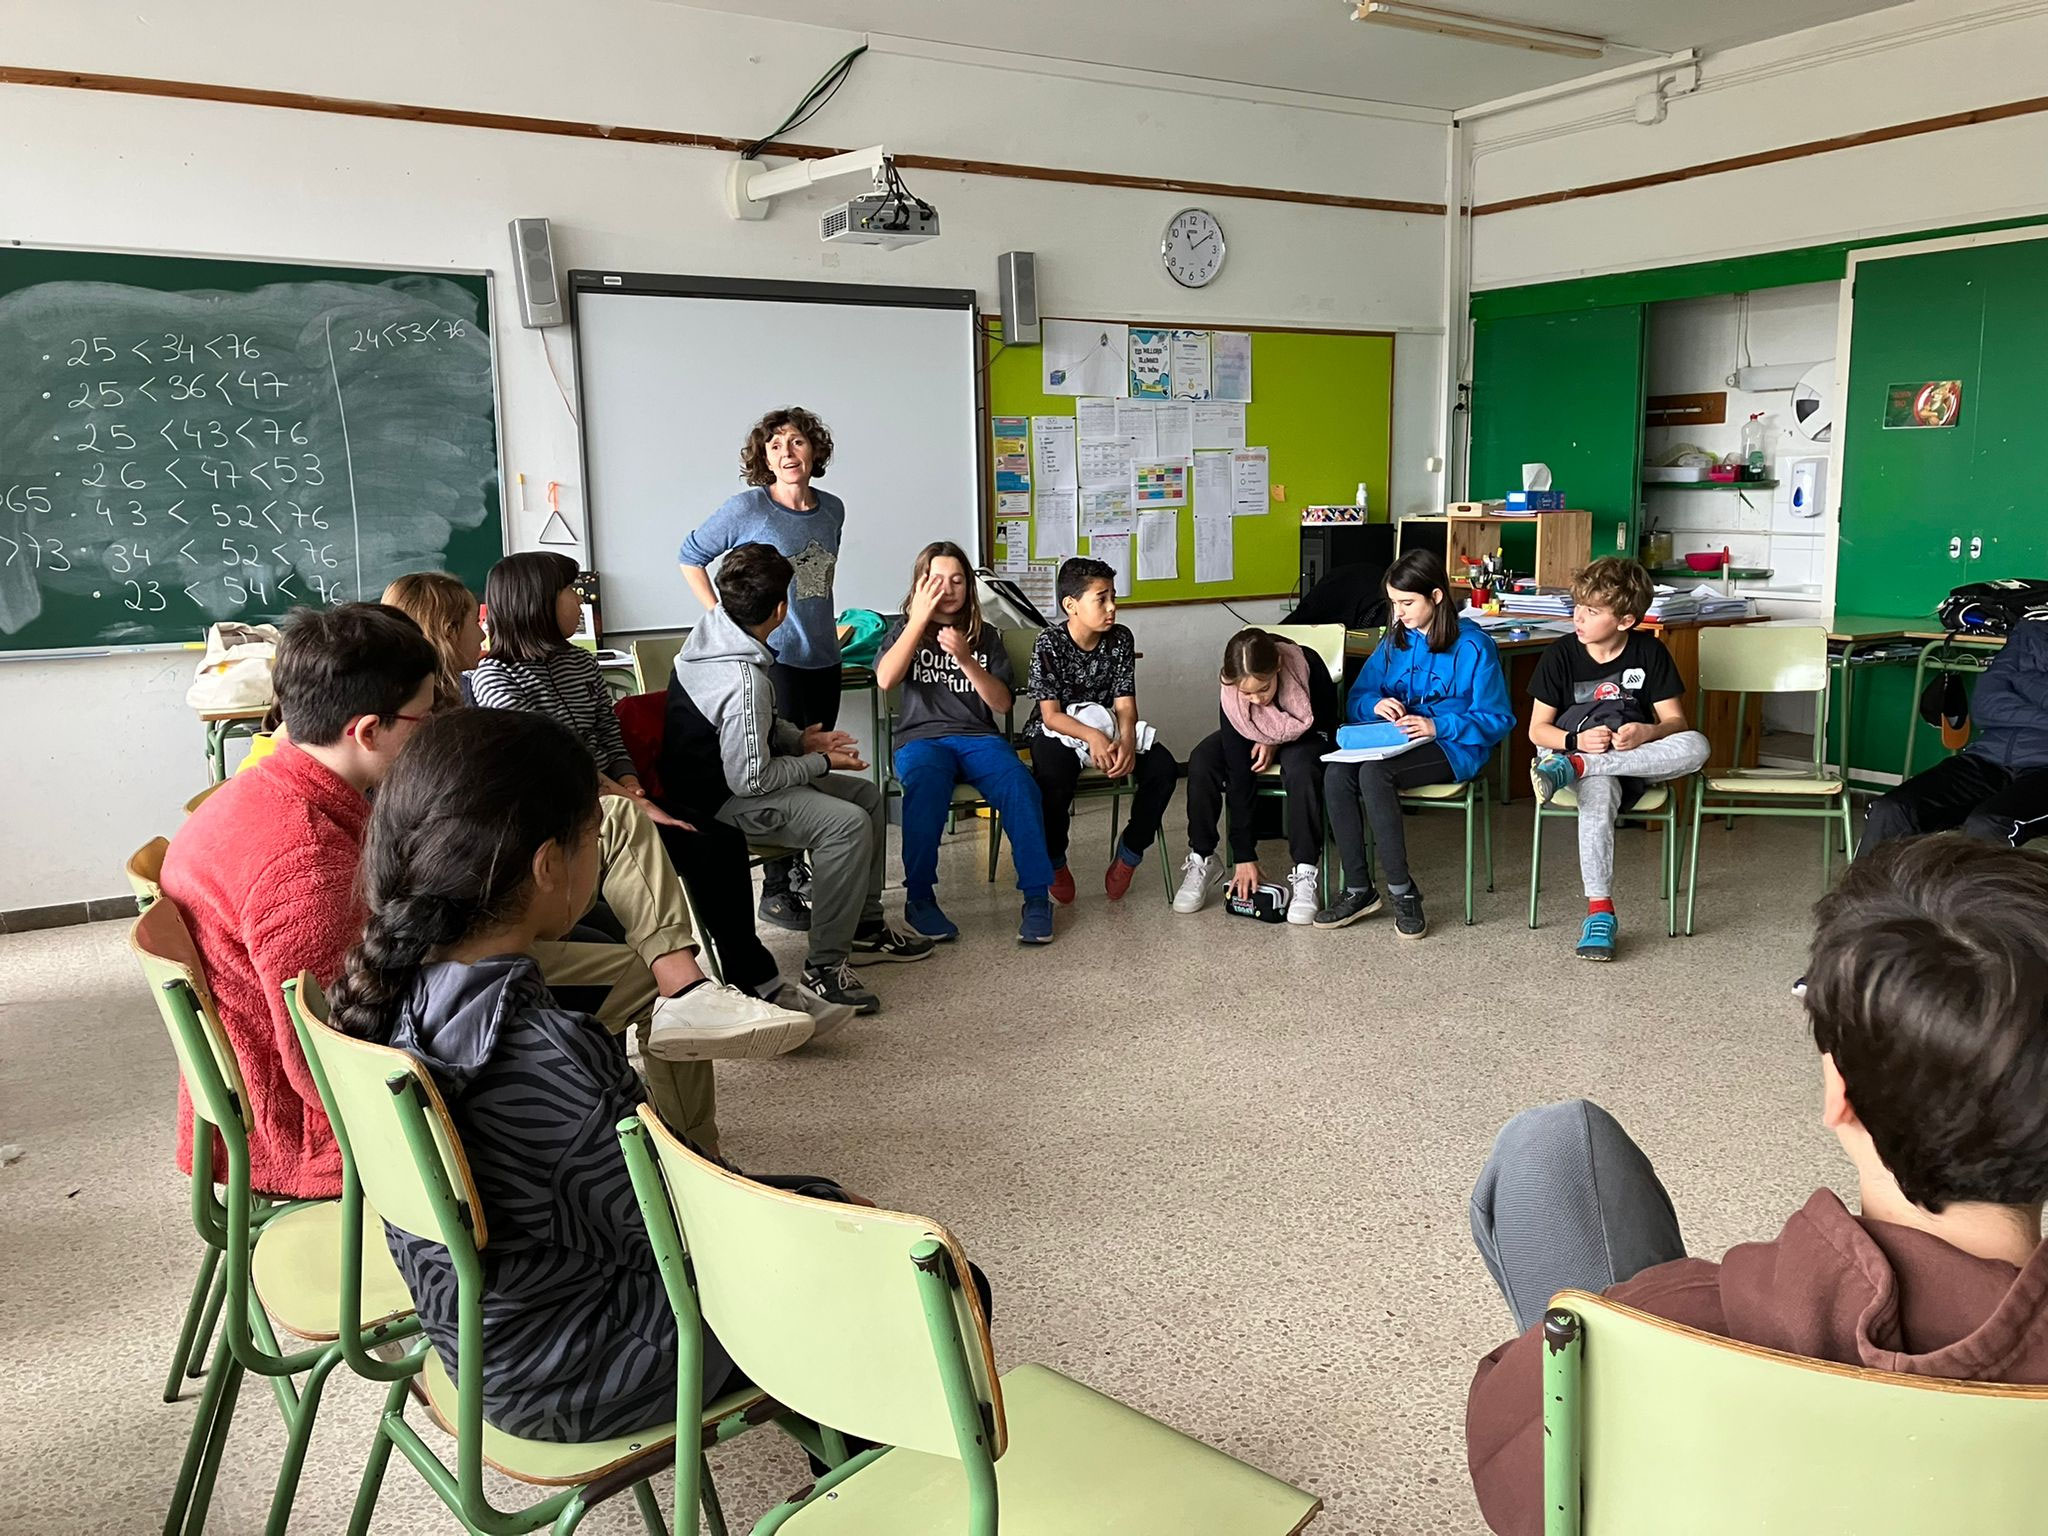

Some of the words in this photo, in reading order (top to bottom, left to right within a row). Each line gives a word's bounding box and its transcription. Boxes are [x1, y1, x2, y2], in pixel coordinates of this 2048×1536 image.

[1180, 220, 1186, 228] 11
[1190, 216, 1197, 225] 12
[1203, 220, 1206, 229] 1
[1172, 228, 1179, 238] 10
[1208, 230, 1214, 239] 2
[1168, 242, 1173, 251] 9
[1212, 245, 1217, 254] 3
[1171, 257, 1176, 266] 8
[1179, 267, 1184, 276] 7
[1189, 271, 1194, 280] 6
[1200, 268, 1205, 277] 5
